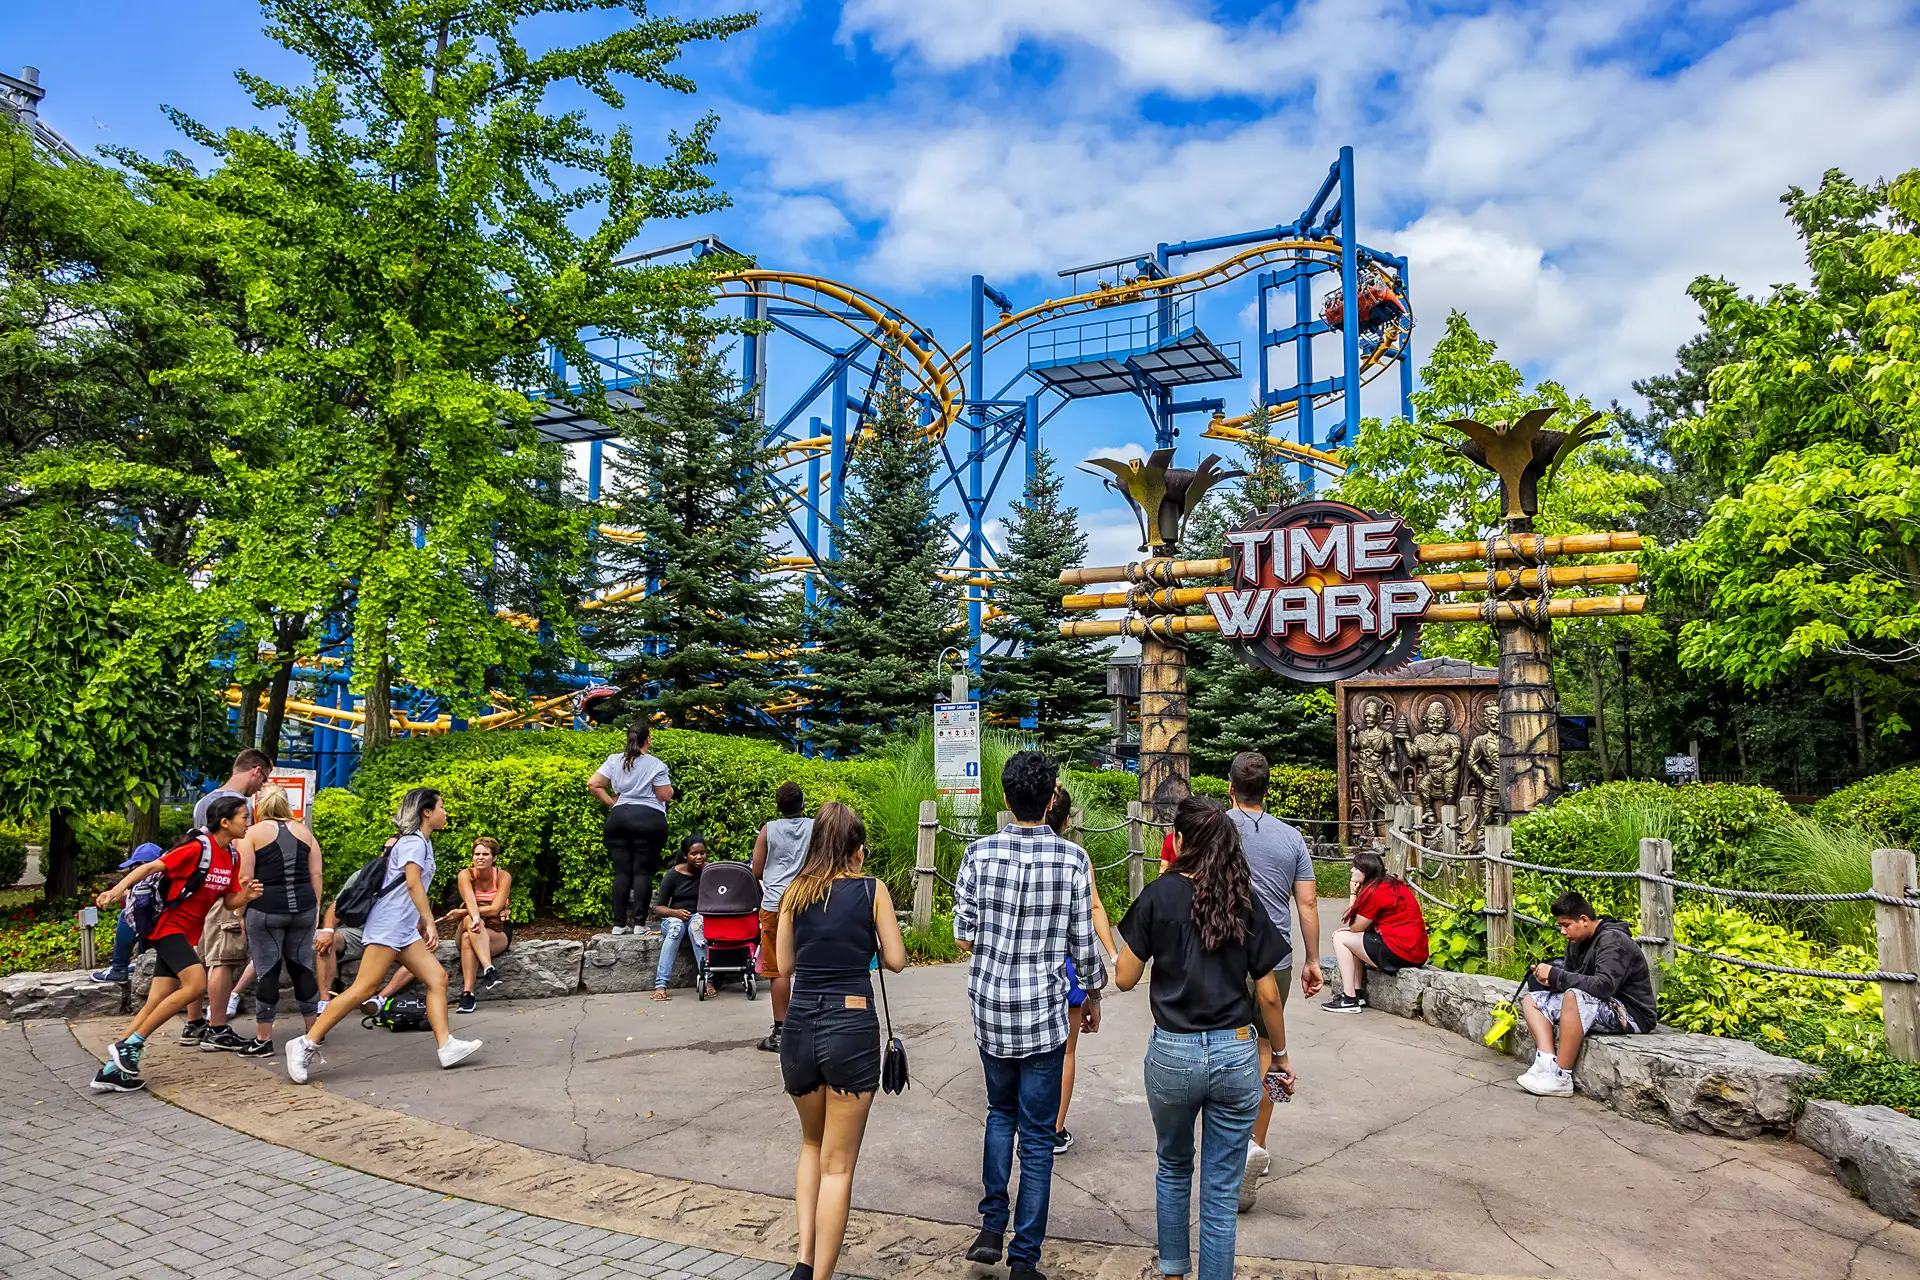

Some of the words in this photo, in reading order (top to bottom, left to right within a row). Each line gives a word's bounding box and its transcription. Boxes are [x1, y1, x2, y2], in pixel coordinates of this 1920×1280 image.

[1225, 519, 1403, 585] TIME
[1205, 581, 1434, 642] WARP
[205, 873, 231, 885] STUDEN
